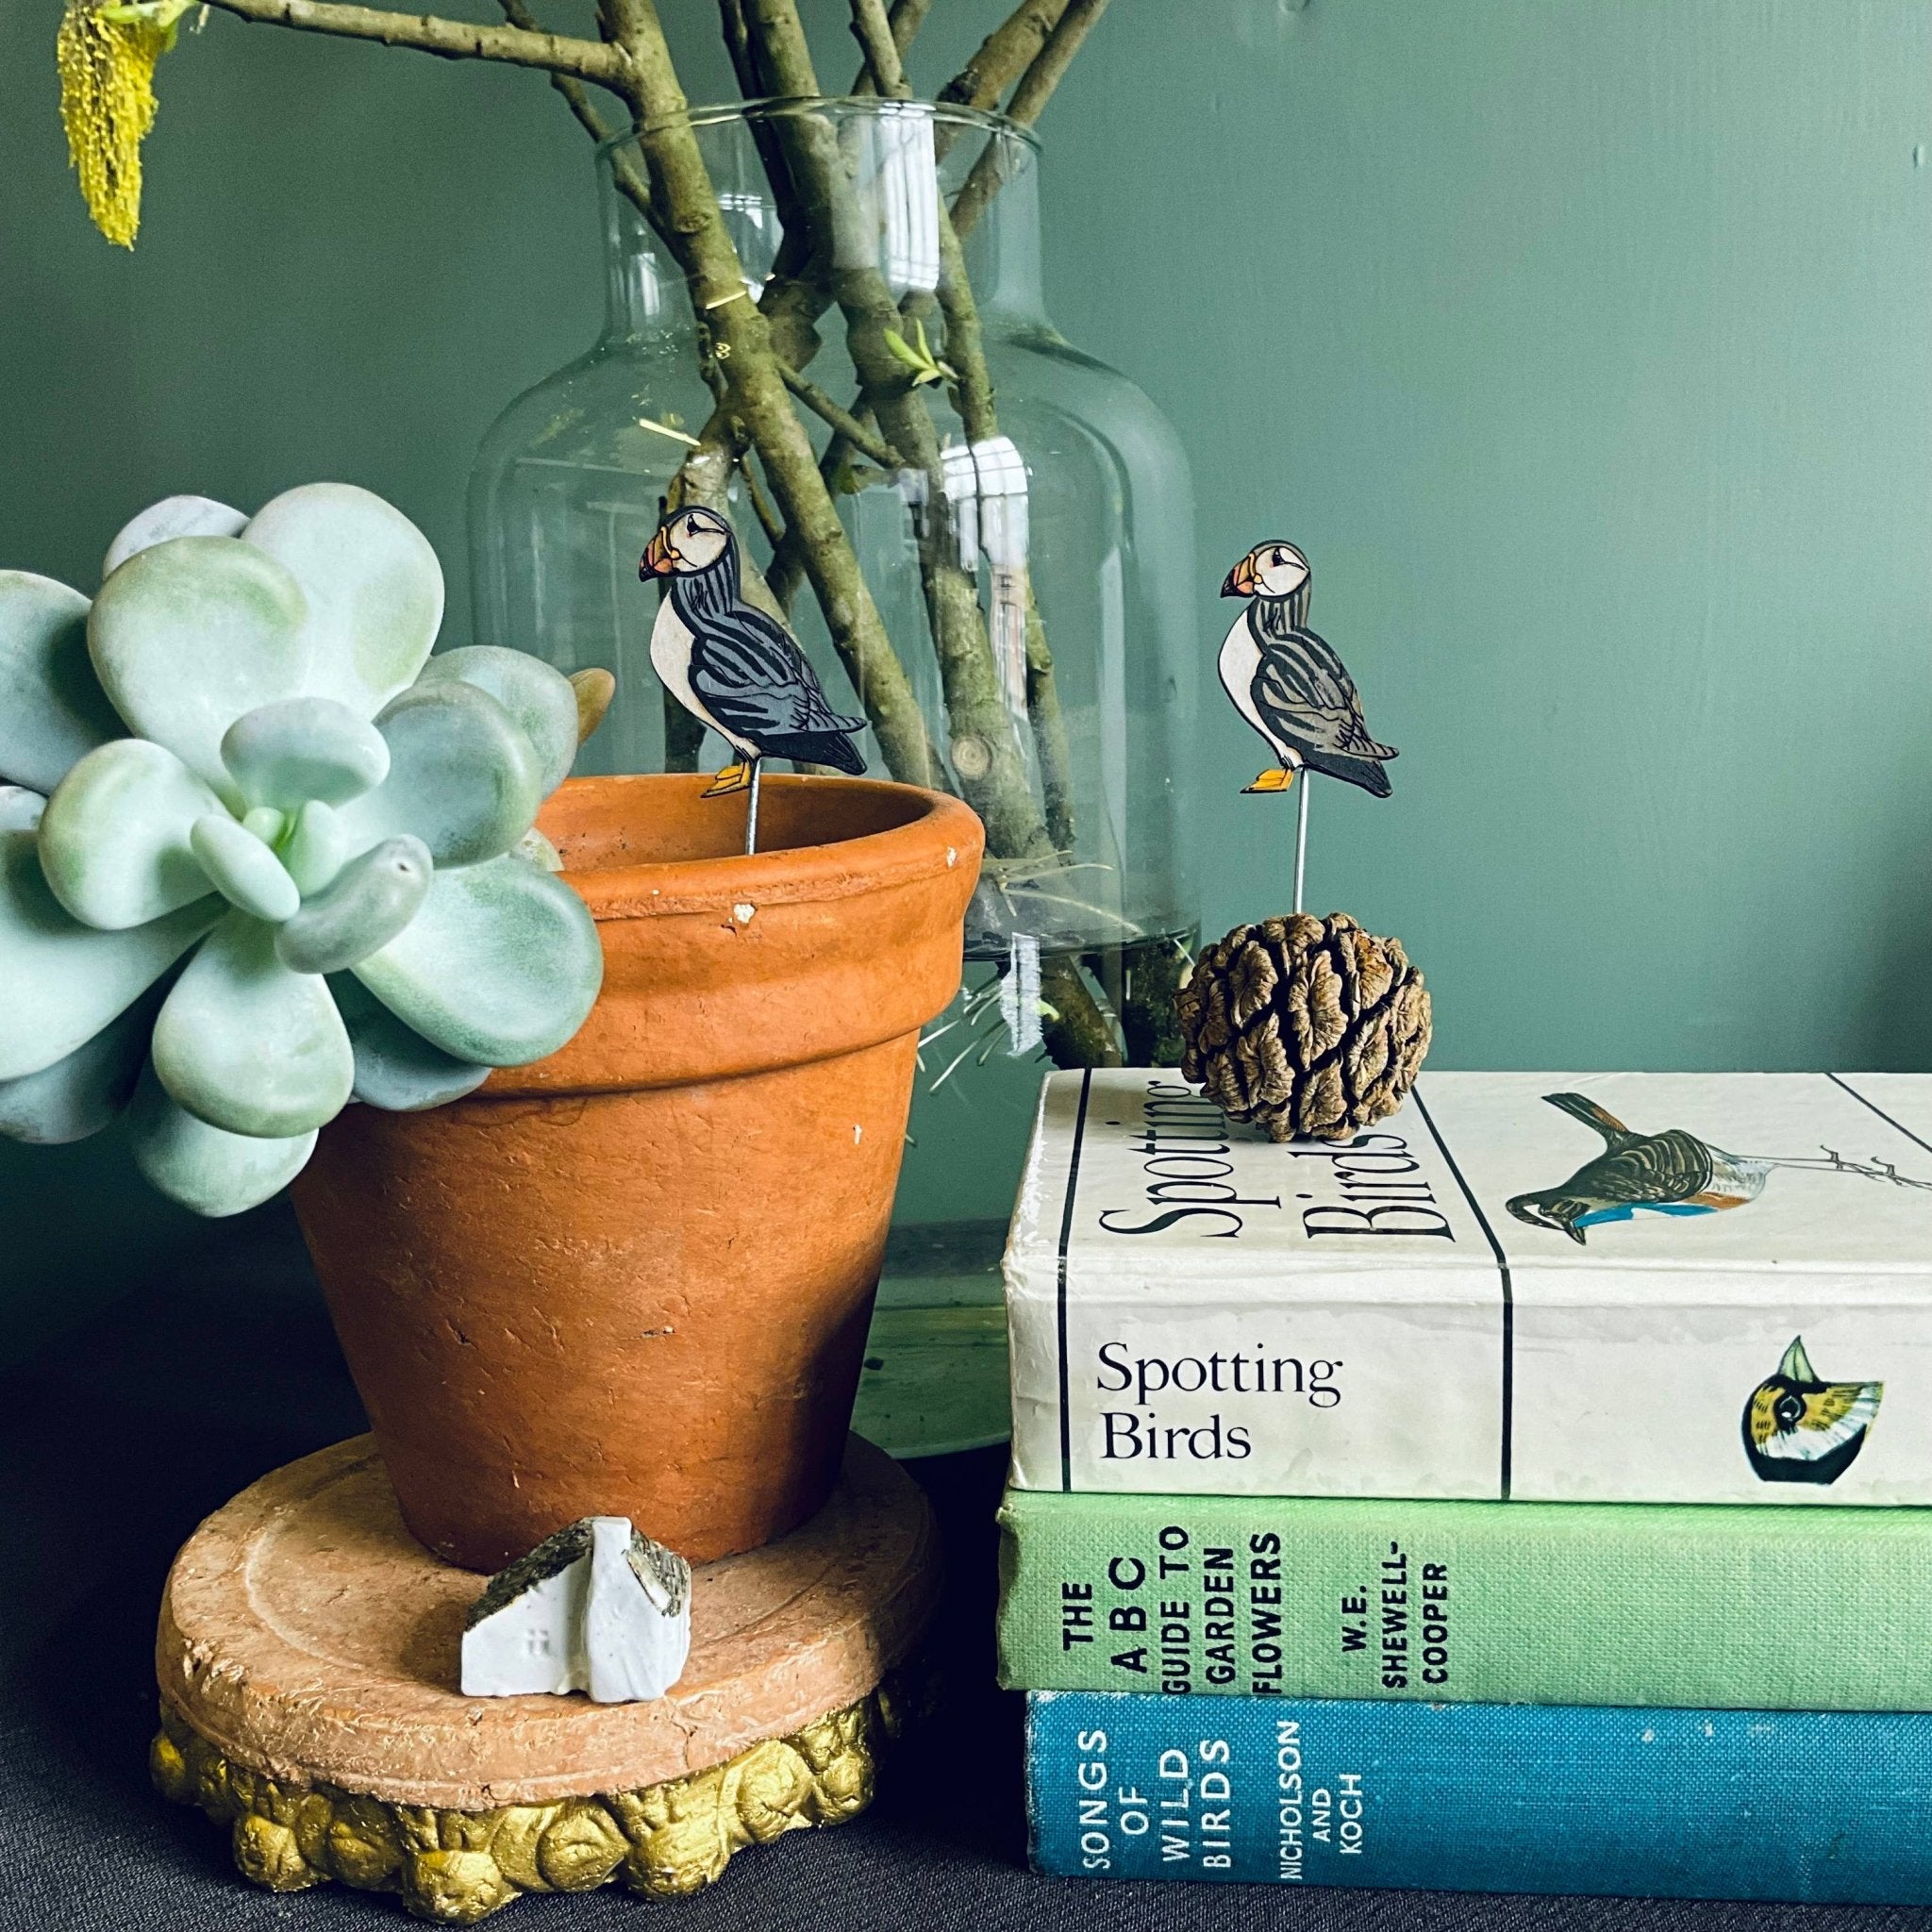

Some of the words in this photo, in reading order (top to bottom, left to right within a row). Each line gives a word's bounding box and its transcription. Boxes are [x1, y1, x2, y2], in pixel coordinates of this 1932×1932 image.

[1287, 1133, 1457, 1243] Birds
[1097, 1341, 1343, 1407] Spotting
[1100, 1412, 1251, 1459] Birds
[1159, 1526, 1190, 1580] TO
[1062, 1581, 1093, 1651] THE
[1161, 1601, 1191, 1695] GUIDE
[1205, 1547, 1236, 1684] GARDEN
[1251, 1532, 1282, 1694] FLOWERS
[1341, 1585, 1367, 1652] W.E.
[1382, 1541, 1408, 1689] SHEWELL-
[1423, 1563, 1448, 1684] COOPER
[1078, 1729, 1110, 1868] SONGS
[1119, 1787, 1149, 1835] OF
[1159, 1750, 1191, 1861] WILD
[1200, 1740, 1231, 1868] BIRDS
[1277, 1721, 1303, 1879] NICHOLSON
[1312, 1789, 1331, 1842] AND
[1340, 1774, 1362, 1854] KOCH
